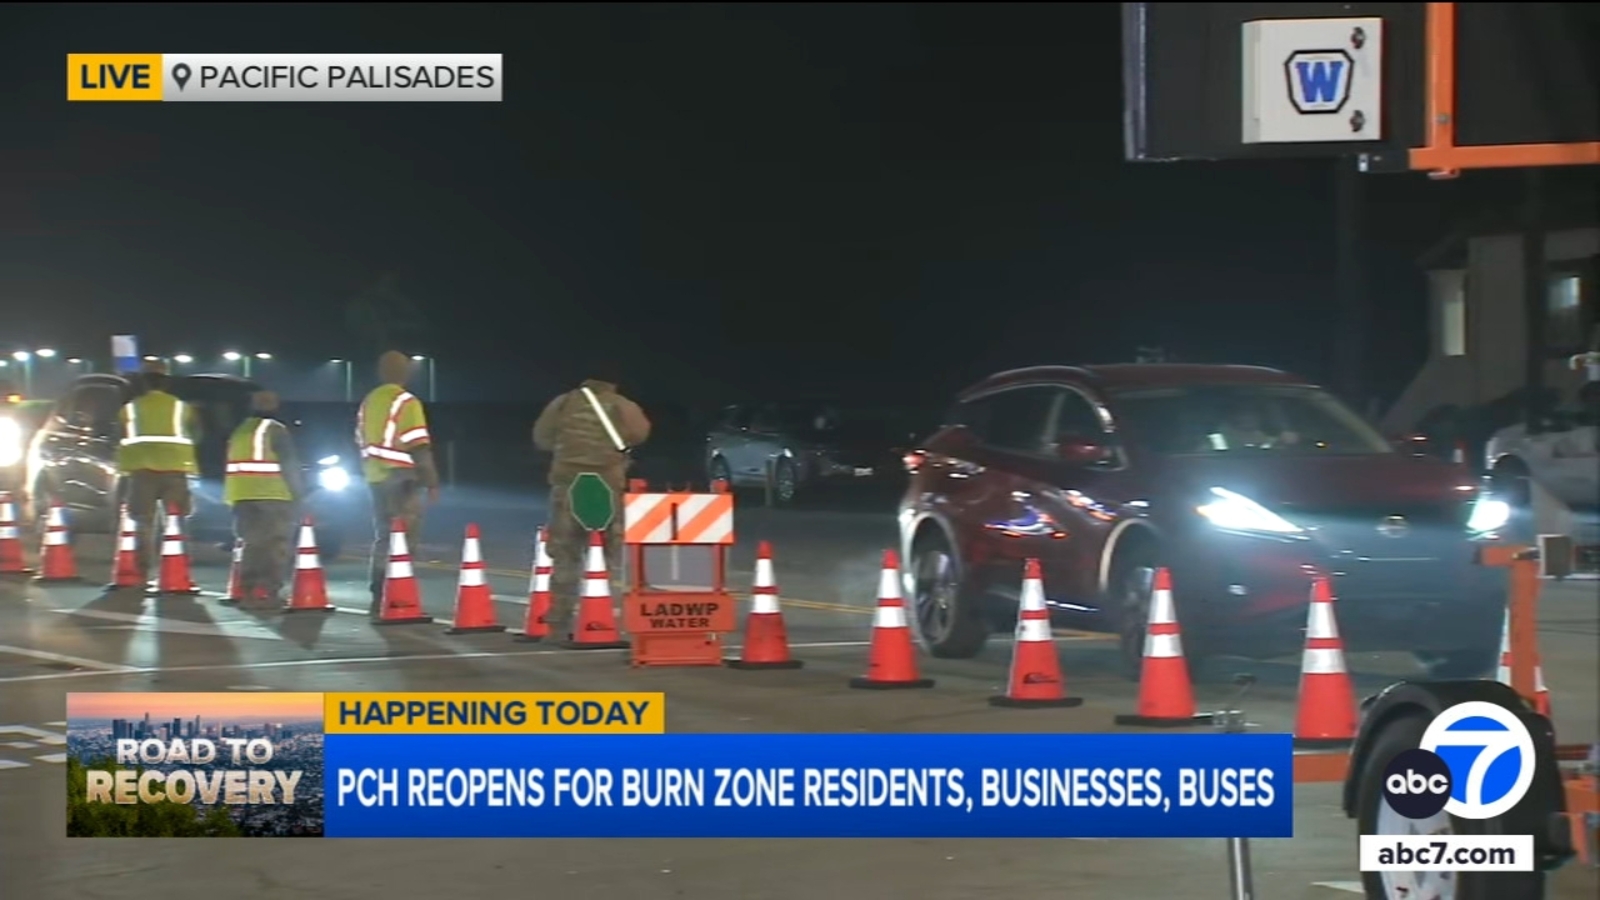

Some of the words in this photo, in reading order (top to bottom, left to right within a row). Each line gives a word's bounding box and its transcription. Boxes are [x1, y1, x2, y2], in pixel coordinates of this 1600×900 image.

[1295, 61, 1344, 103] W
[640, 603, 719, 617] LADWP
[650, 617, 710, 628] WATER
